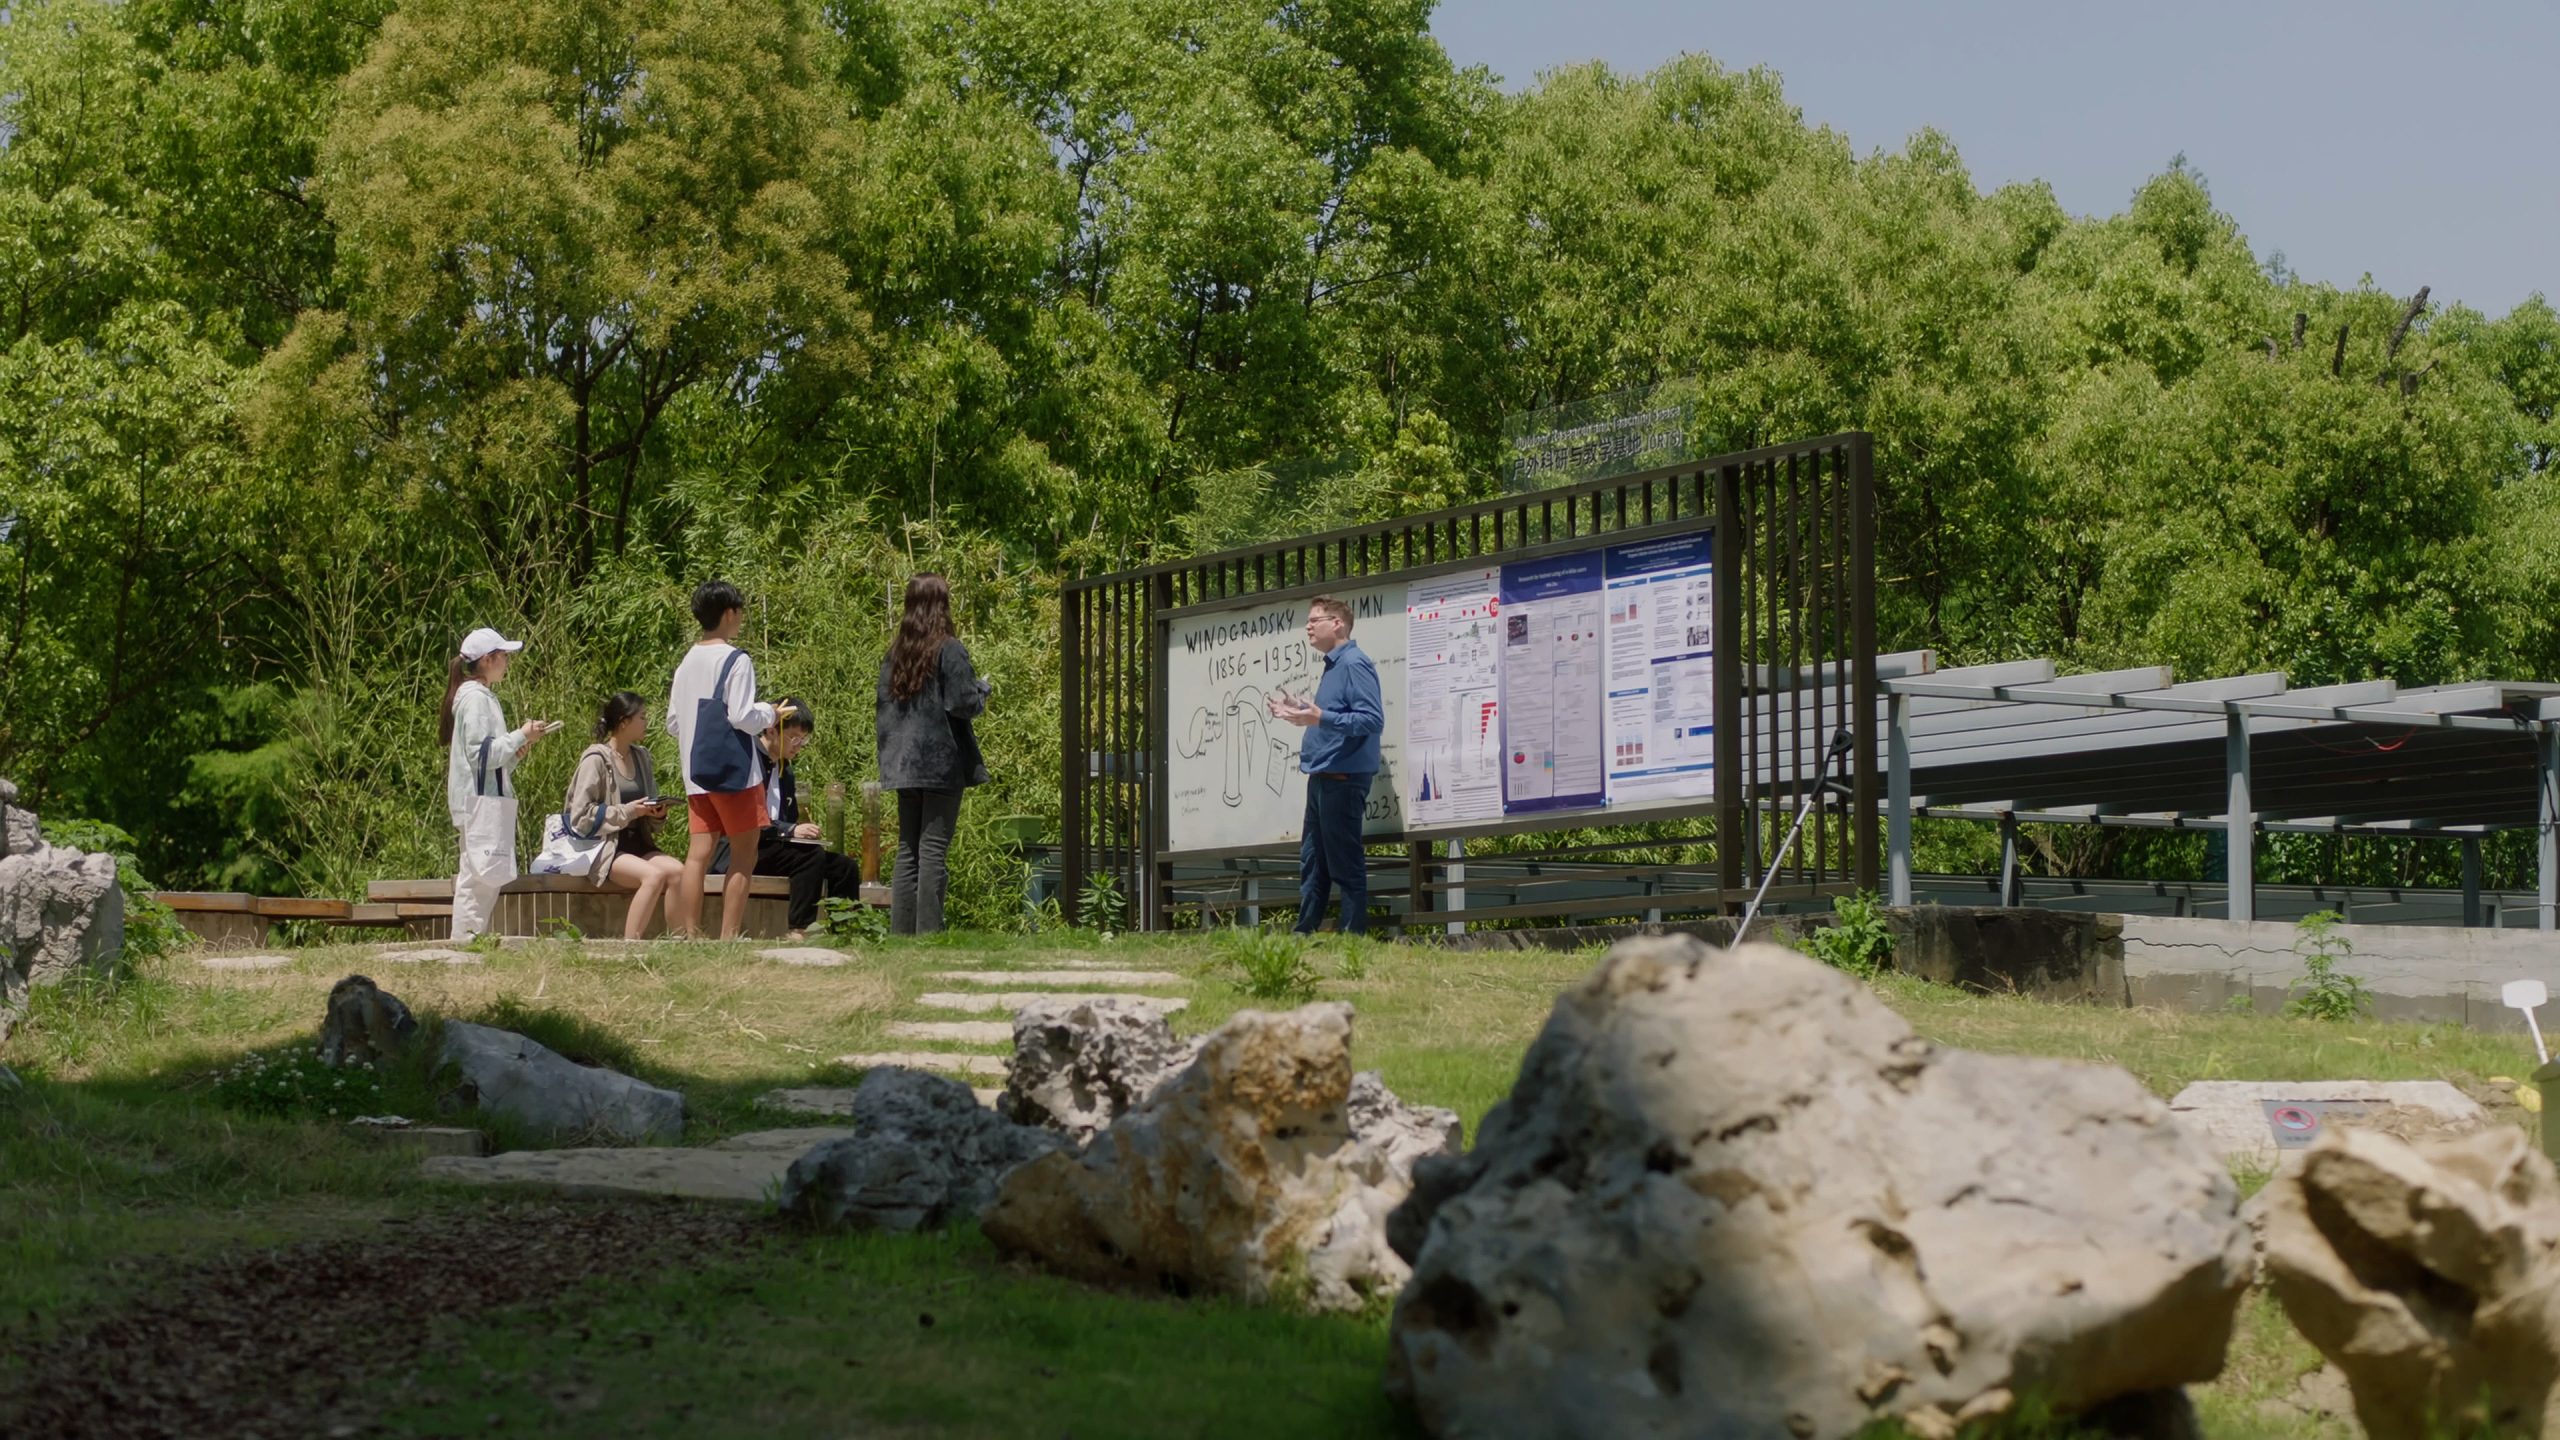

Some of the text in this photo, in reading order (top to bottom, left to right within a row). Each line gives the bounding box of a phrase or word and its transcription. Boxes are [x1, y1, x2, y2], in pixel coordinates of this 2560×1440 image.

[1613, 410, 1651, 431] Teaching
[1513, 432, 1643, 481] 户外科研与教学基地
[1185, 609, 1295, 655] WINOGRADSKY
